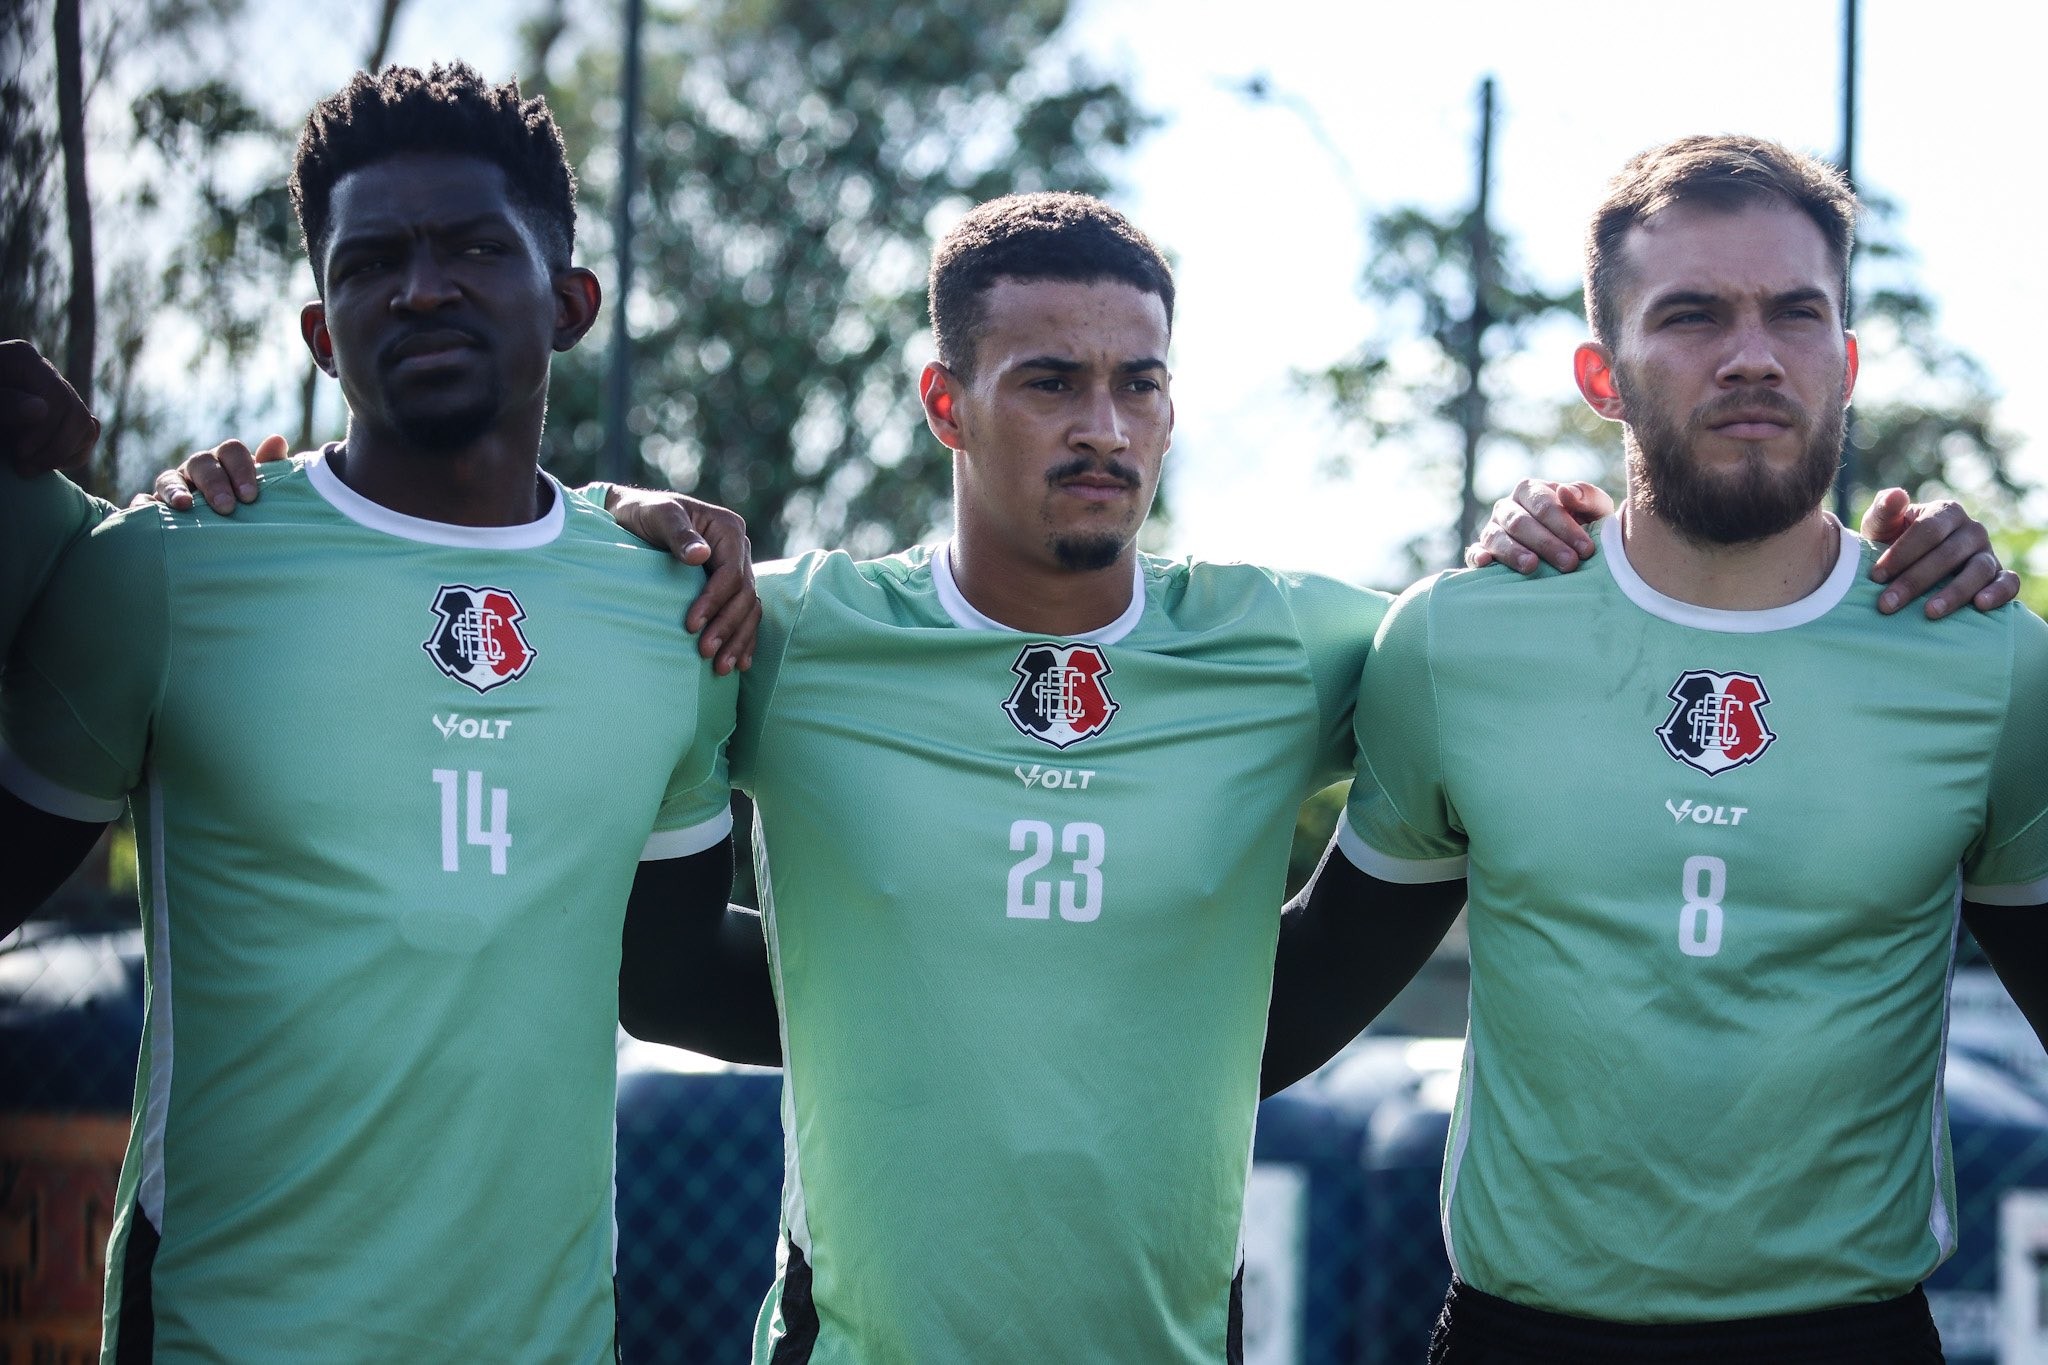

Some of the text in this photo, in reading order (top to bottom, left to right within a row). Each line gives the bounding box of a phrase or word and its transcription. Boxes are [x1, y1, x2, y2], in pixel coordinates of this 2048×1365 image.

[432, 714, 512, 739] VOLT
[1014, 765, 1095, 789] VOLT
[432, 769, 512, 875] 14
[1665, 799, 1748, 825] VOLT
[1006, 820, 1105, 922] 23
[1678, 855, 1726, 957] 8
